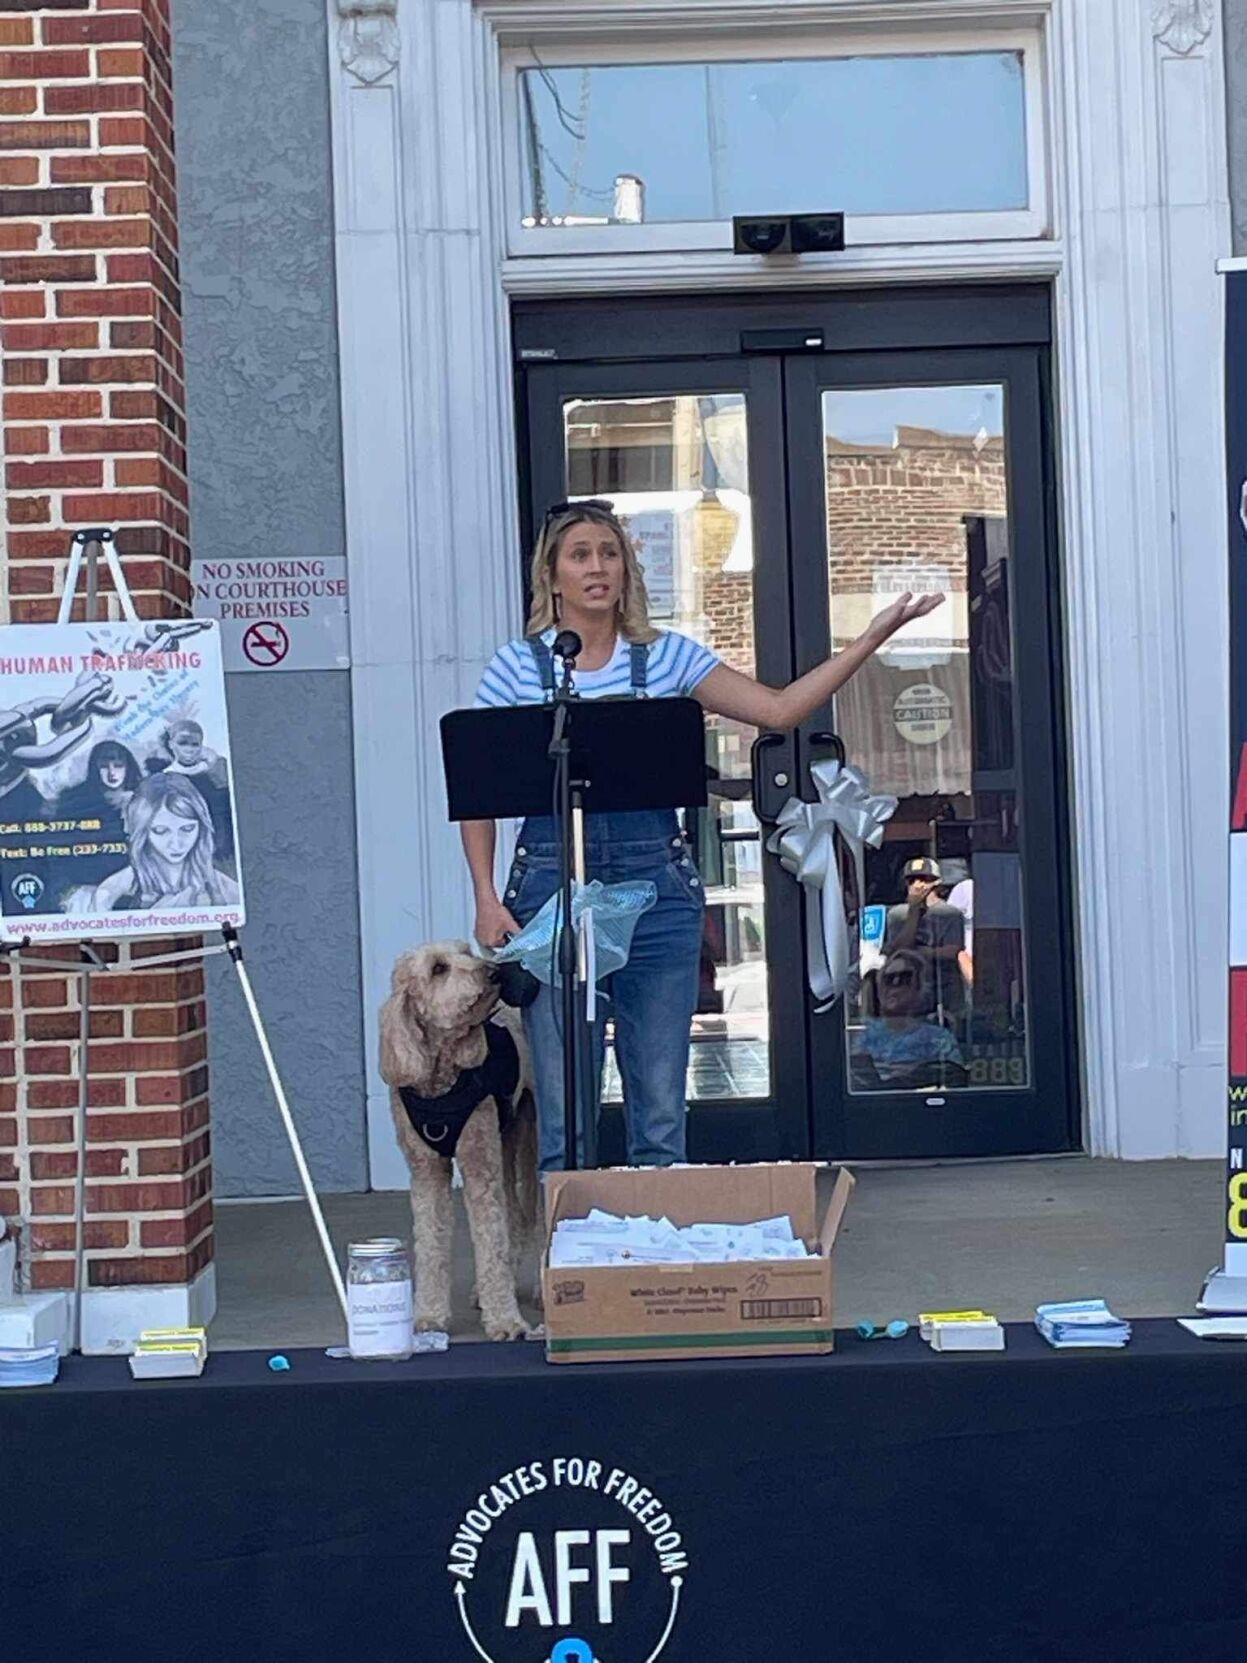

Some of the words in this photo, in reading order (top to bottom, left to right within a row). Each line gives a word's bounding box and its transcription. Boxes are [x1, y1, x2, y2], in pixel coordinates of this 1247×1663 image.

[202, 562, 232, 580] NO
[236, 560, 325, 579] SMOKING
[215, 579, 348, 600] COURTHOUSE
[220, 601, 310, 620] PREMISES
[0, 655, 74, 675] HUMAN
[7, 911, 240, 936] www.advocatesforfreedom.org
[1230, 1148, 1243, 1169] N
[447, 1461, 548, 1579] ADVOCATES
[552, 1457, 602, 1490] FOR
[603, 1467, 690, 1574] FREEDOM
[504, 1528, 631, 1627] AFF
